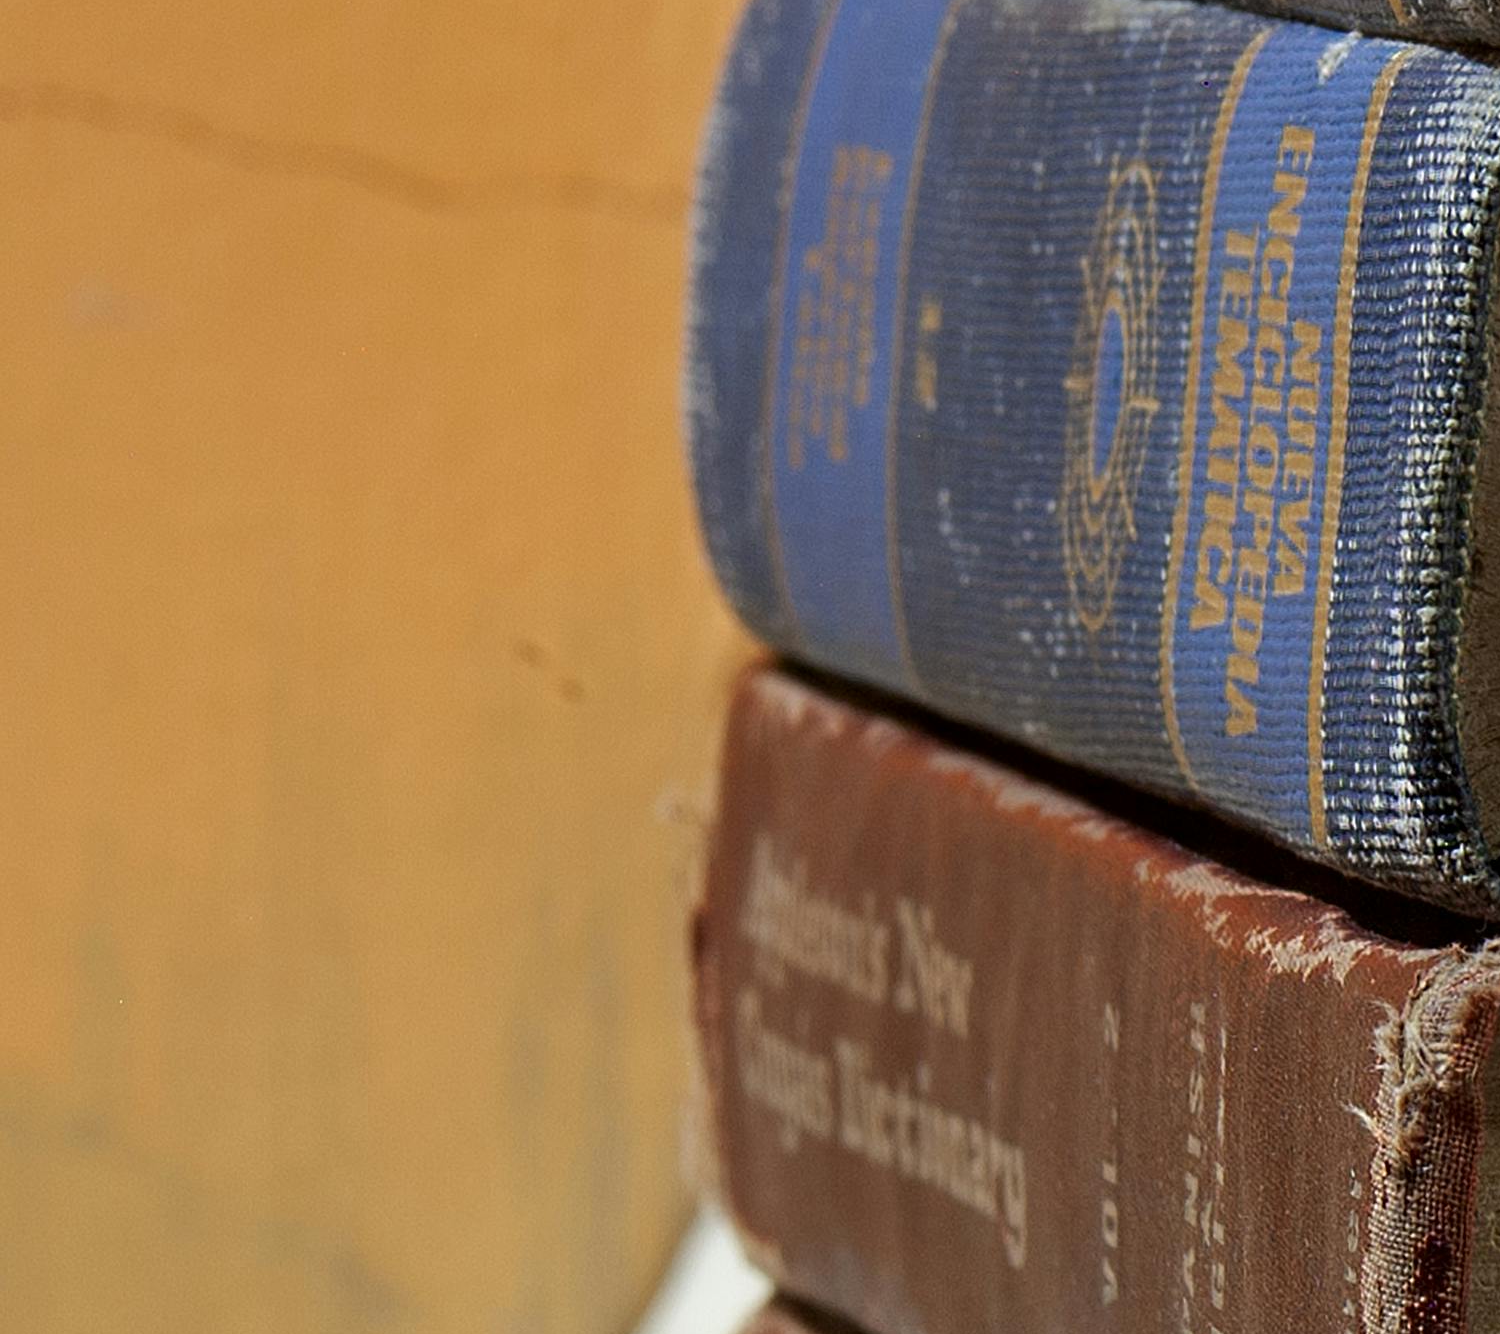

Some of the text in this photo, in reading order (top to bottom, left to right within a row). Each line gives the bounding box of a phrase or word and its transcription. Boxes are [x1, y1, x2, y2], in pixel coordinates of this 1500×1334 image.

[1189, 225, 1261, 633] TEMATICA
[1225, 123, 1316, 739] ENCICLOPEDIA
[1271, 319, 1323, 599] NUEVA
